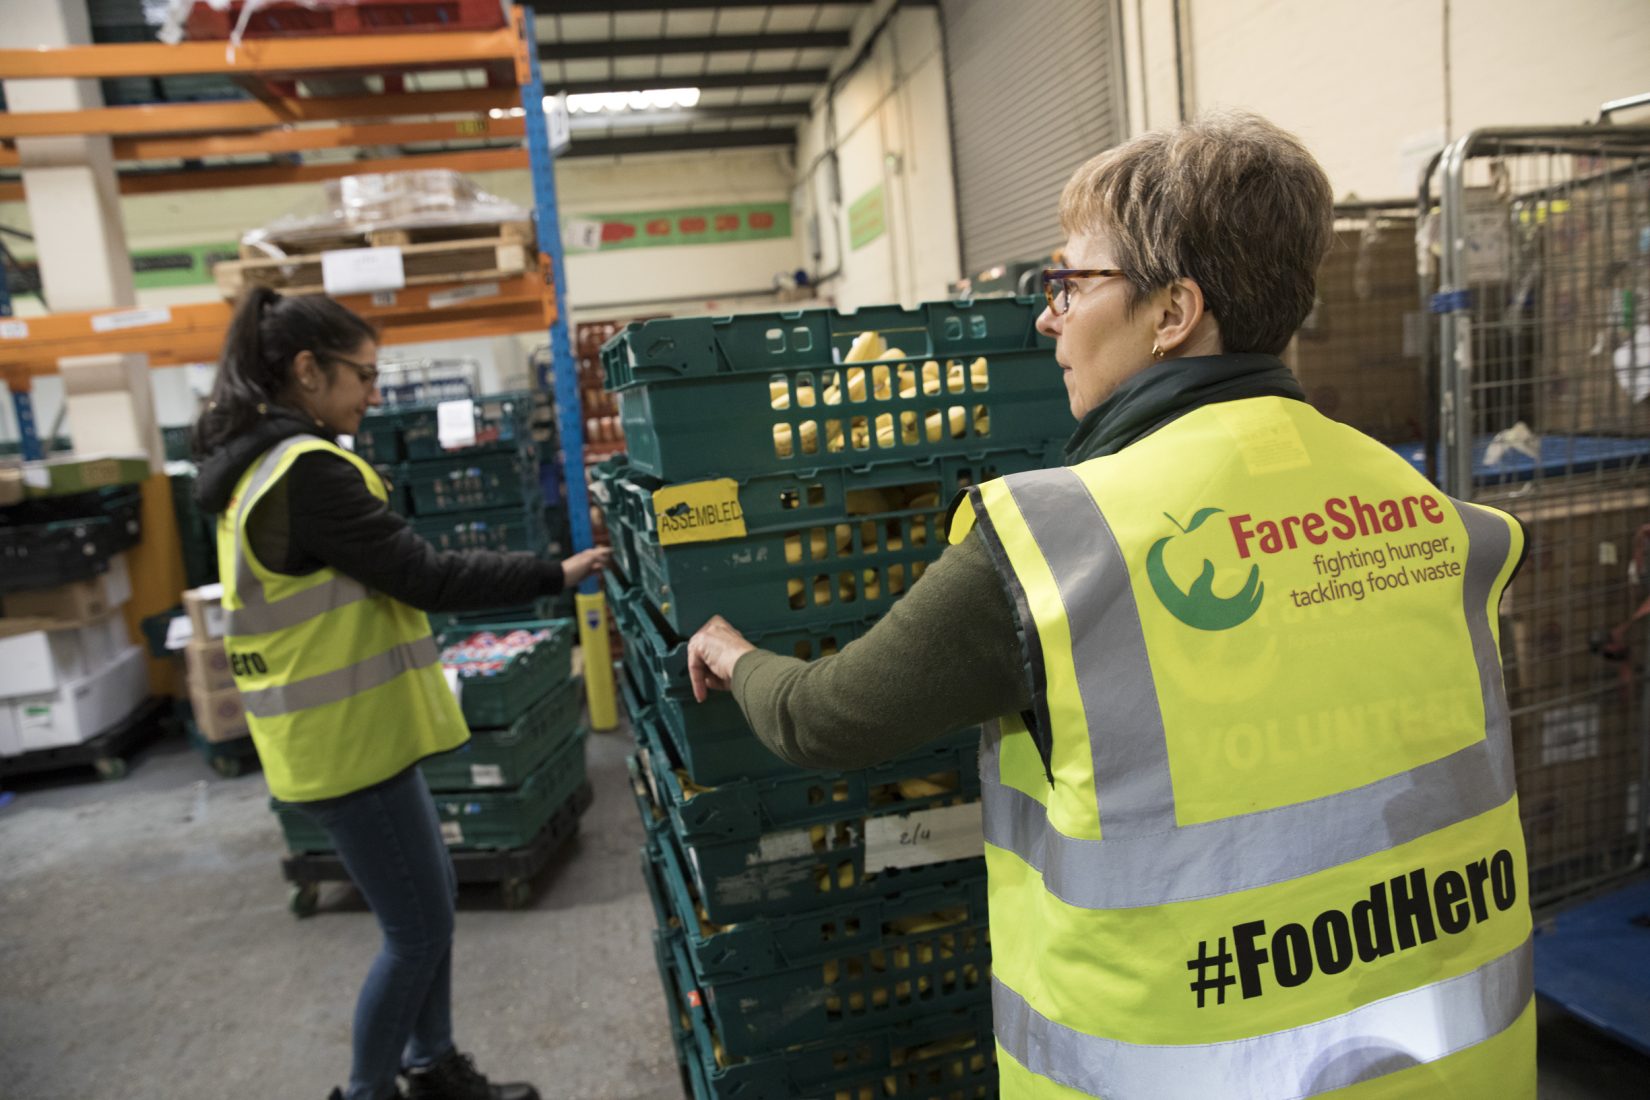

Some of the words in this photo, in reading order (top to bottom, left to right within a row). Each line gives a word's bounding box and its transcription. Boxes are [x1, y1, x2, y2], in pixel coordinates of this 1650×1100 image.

[661, 500, 741, 532] ASSEMBLED
[1228, 494, 1445, 559] FareShare
[1313, 548, 1387, 578] fighting
[1386, 536, 1455, 561] hunger,
[1290, 580, 1365, 607] tackling
[1367, 566, 1409, 592] food
[1410, 561, 1462, 584] waste
[1187, 848, 1517, 1008] #FoodHero
